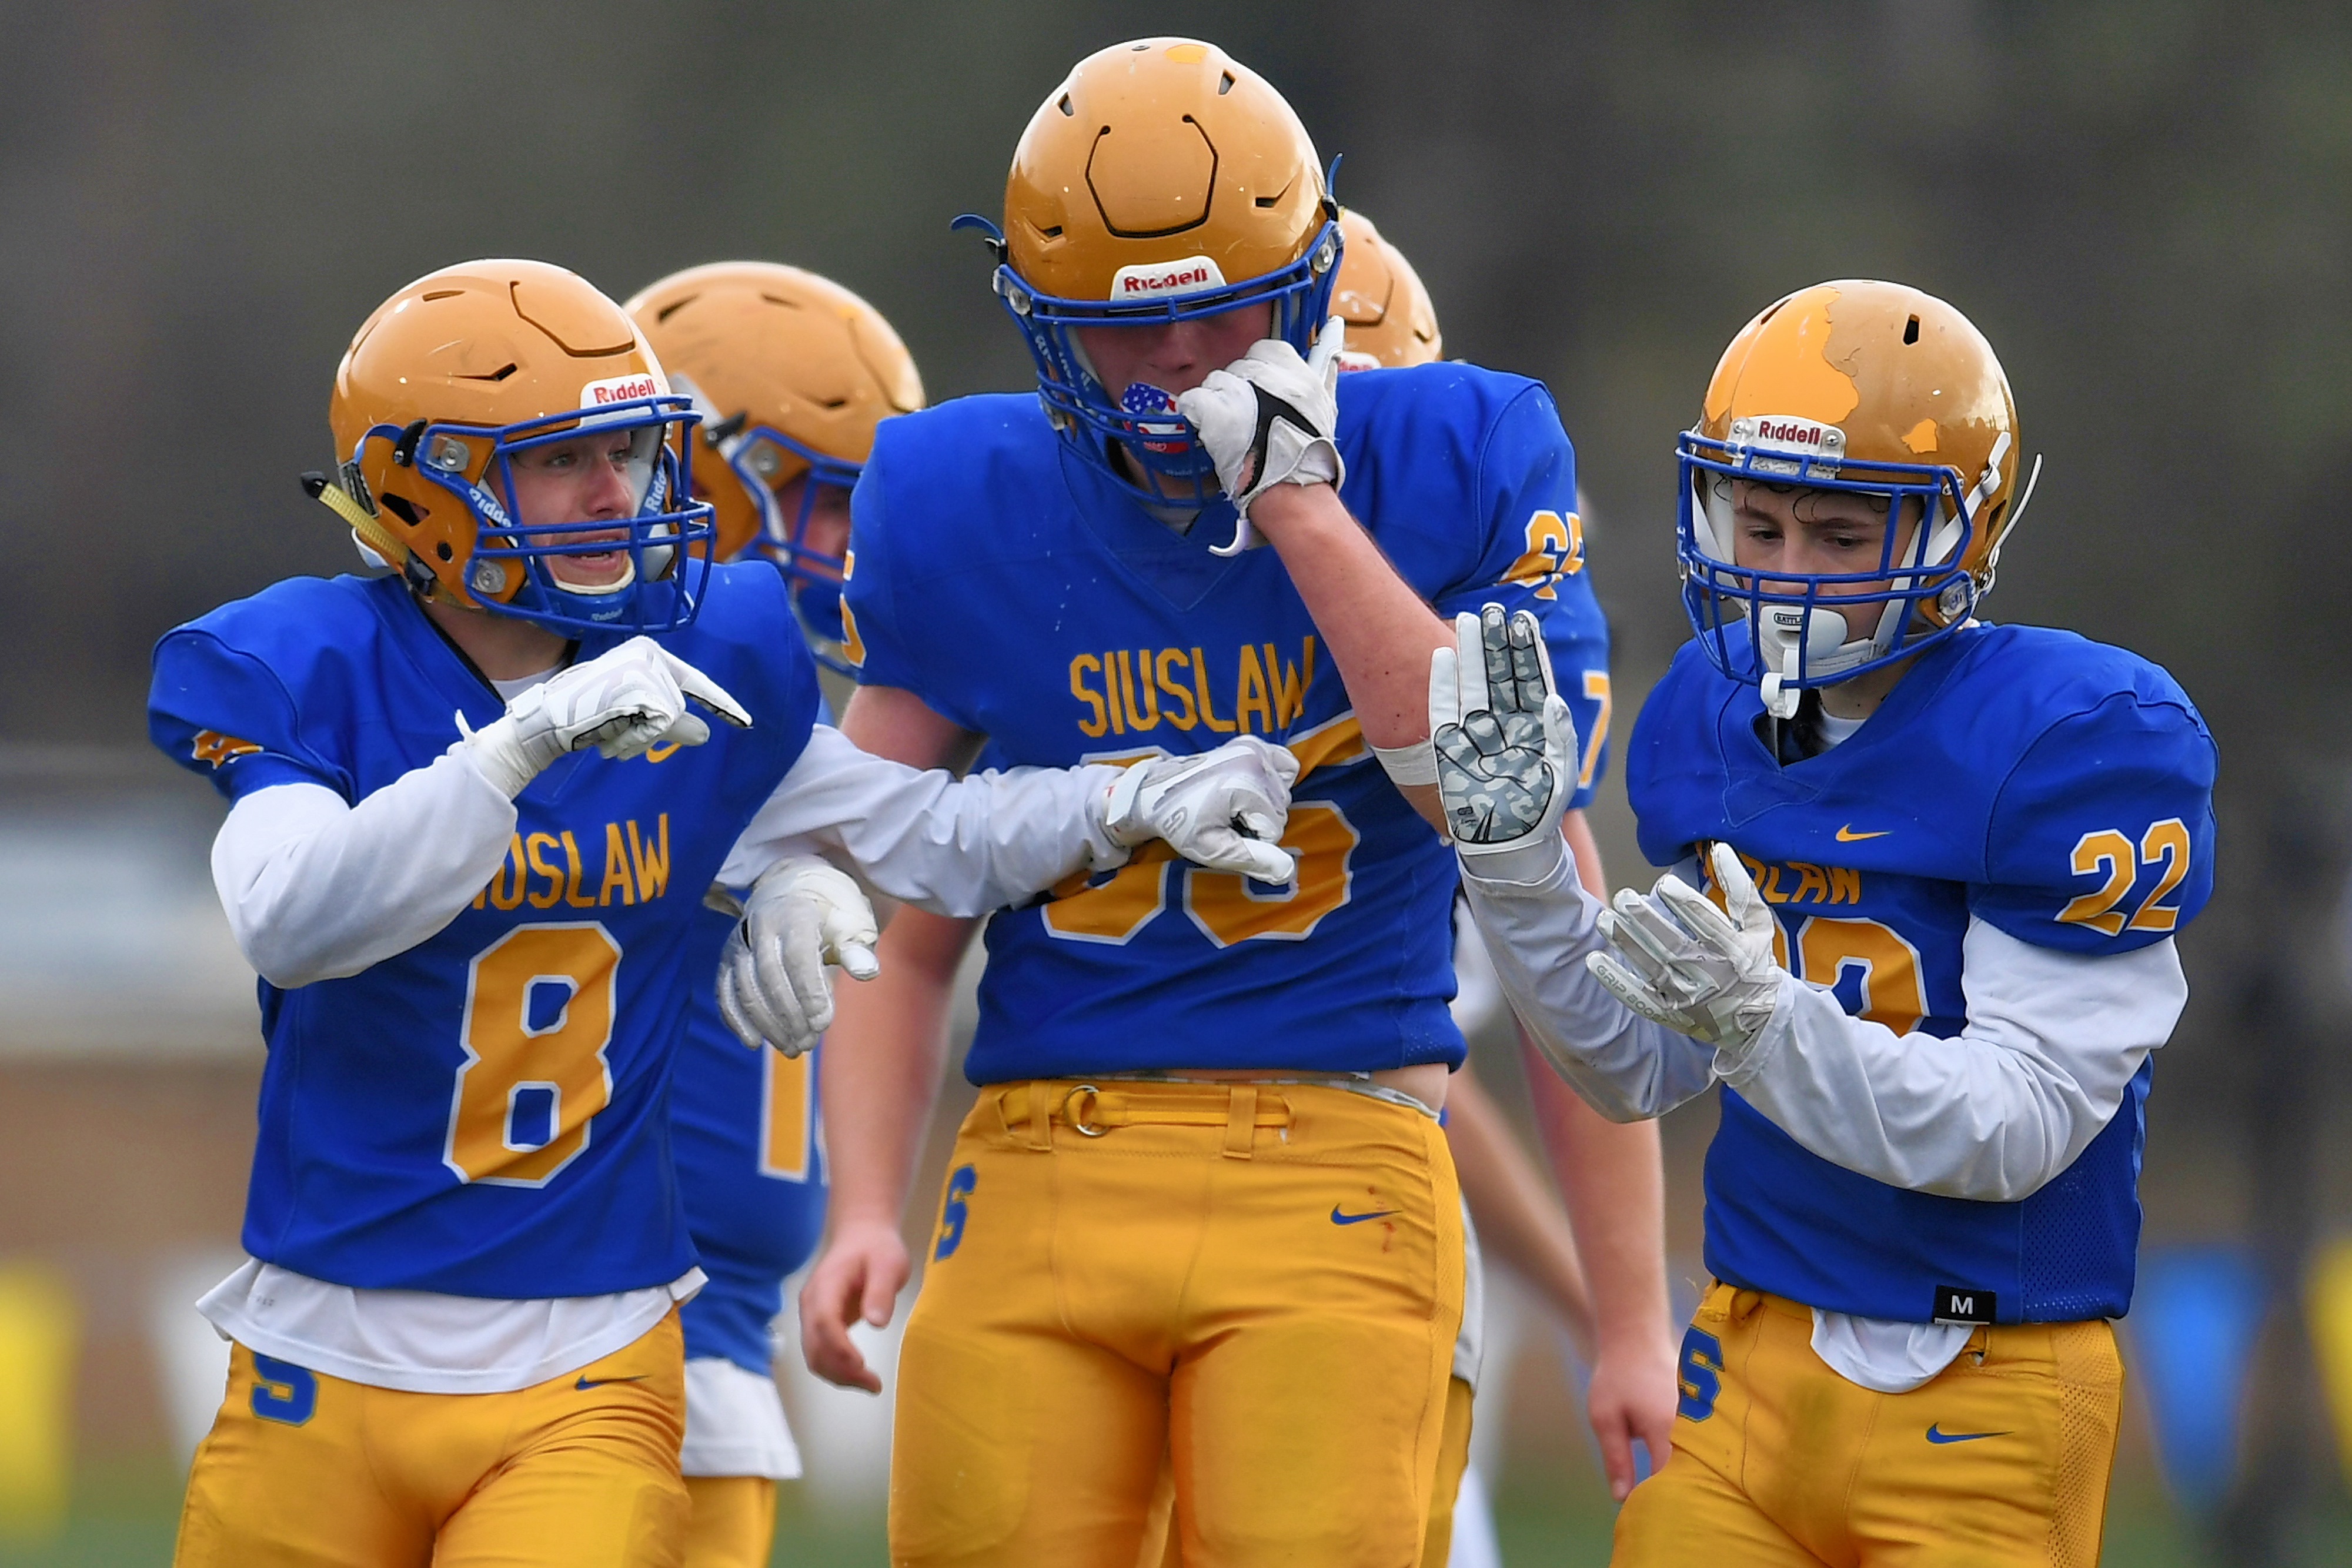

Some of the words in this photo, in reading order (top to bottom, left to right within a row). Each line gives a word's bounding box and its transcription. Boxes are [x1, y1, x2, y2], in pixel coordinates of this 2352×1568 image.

[1124, 268, 1209, 292] Riddell
[593, 379, 656, 404] Riddell
[1759, 420, 1820, 445] Riddell
[1069, 635, 1315, 737] SIUSLAW
[2054, 817, 2191, 937] 22
[1596, 964, 1627, 994] GRIP
[443, 920, 623, 1189] 8
[933, 1162, 977, 1263] S
[1950, 1295, 1973, 1315] M
[1676, 1323, 1725, 1424] S
